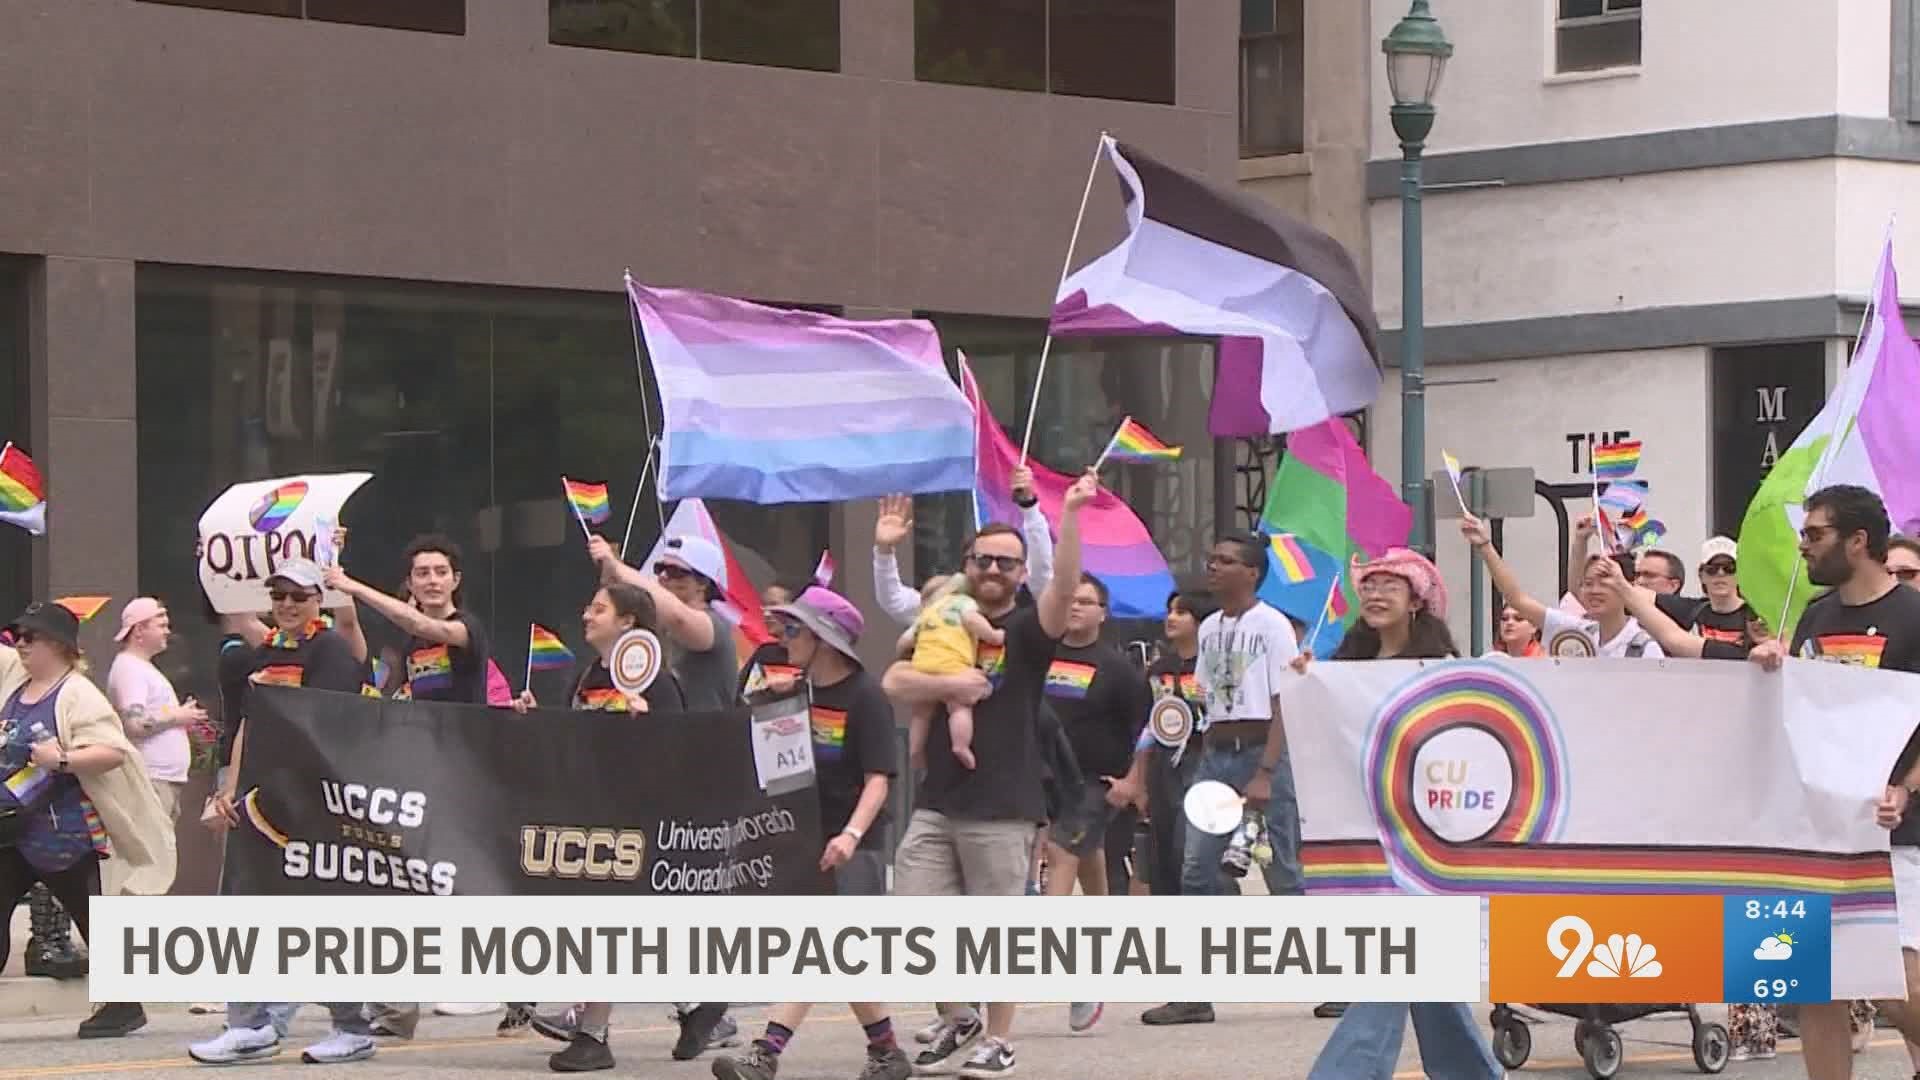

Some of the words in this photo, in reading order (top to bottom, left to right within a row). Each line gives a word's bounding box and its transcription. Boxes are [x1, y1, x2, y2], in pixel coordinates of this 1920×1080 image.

[1426, 760, 1468, 784] CU
[321, 779, 427, 828] UCCS
[1427, 788, 1496, 810] PRIDE
[284, 841, 457, 896] SUCCESS
[520, 825, 646, 880] UCCS
